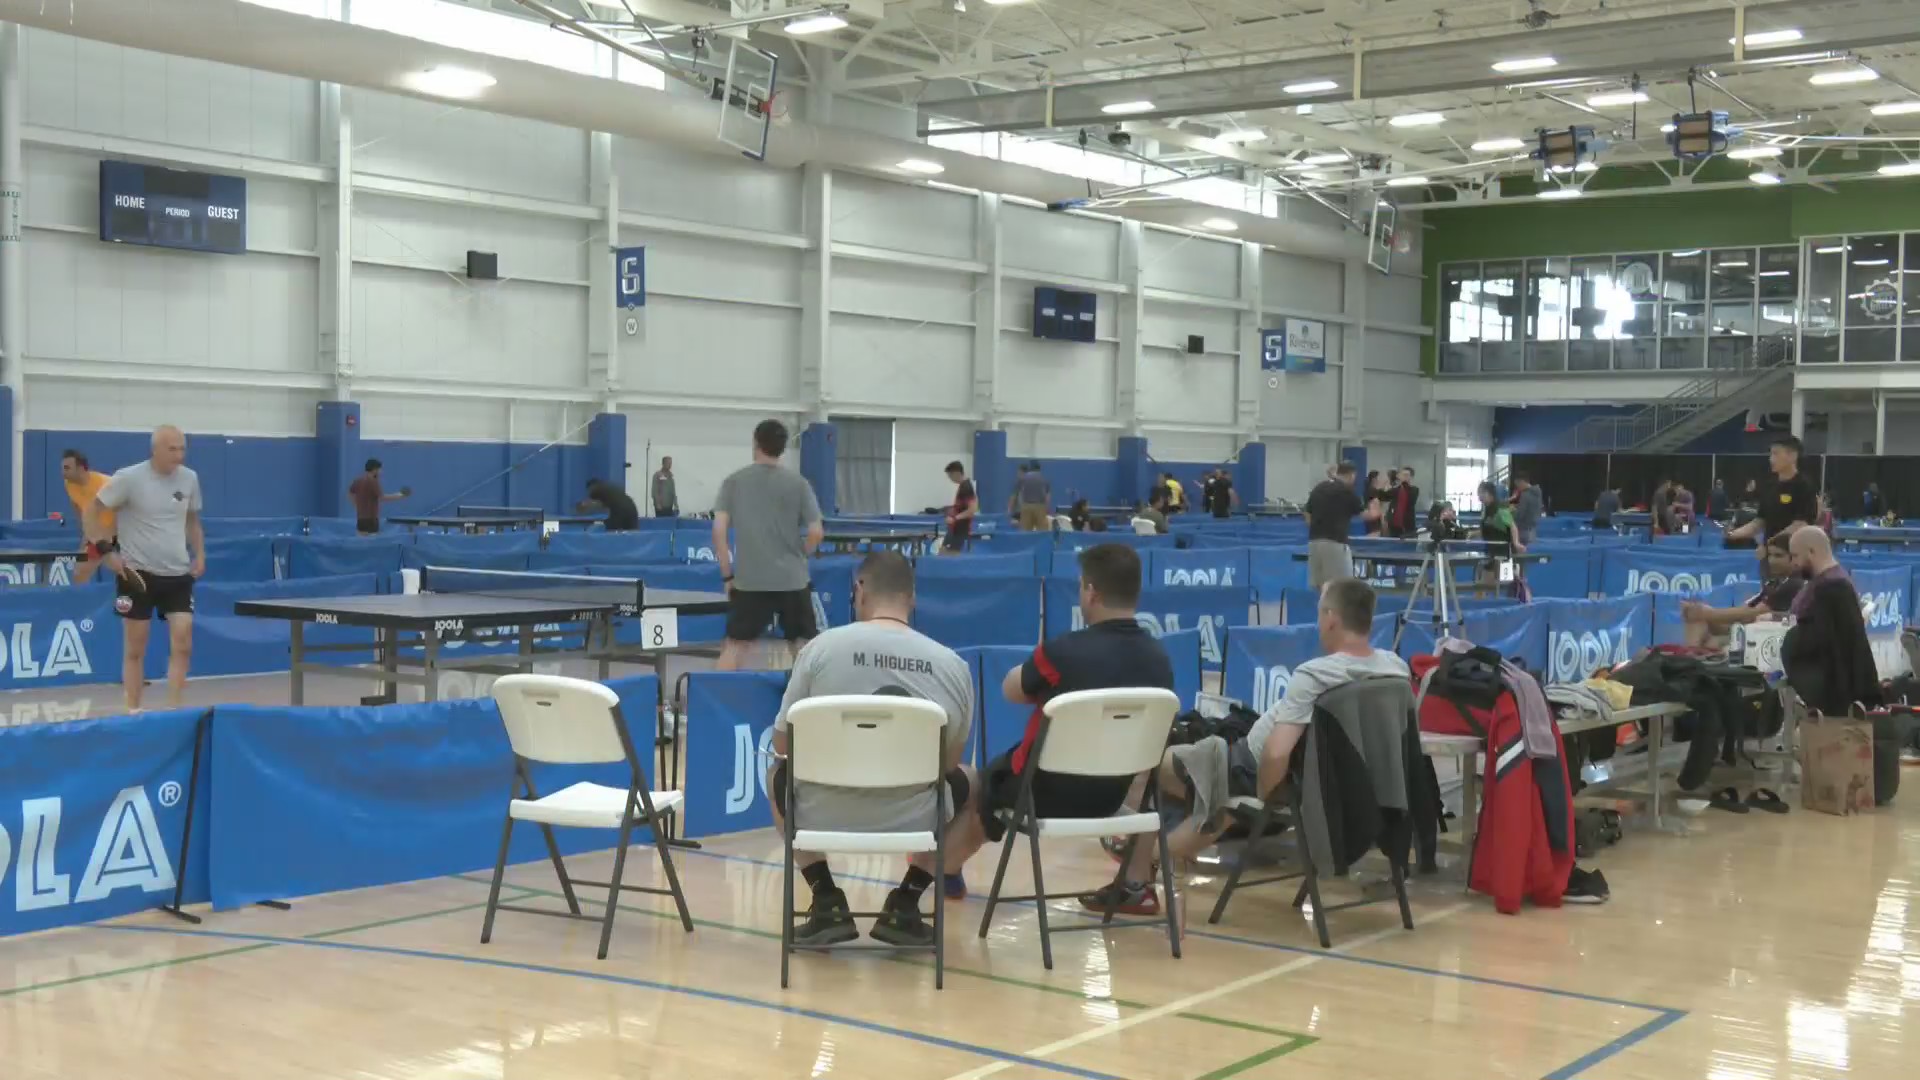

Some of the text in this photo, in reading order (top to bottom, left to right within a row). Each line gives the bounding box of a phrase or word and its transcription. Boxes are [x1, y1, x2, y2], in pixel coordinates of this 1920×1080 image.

[115, 194, 145, 209] HOME
[165, 207, 190, 218] PERIOD
[207, 205, 239, 220] GUEST
[1265, 335, 1282, 361] 5
[316, 613, 338, 624] JOOLA
[435, 619, 464, 631] JOOLA
[653, 624, 664, 646] 8
[853, 652, 933, 675] M. HIGUERA
